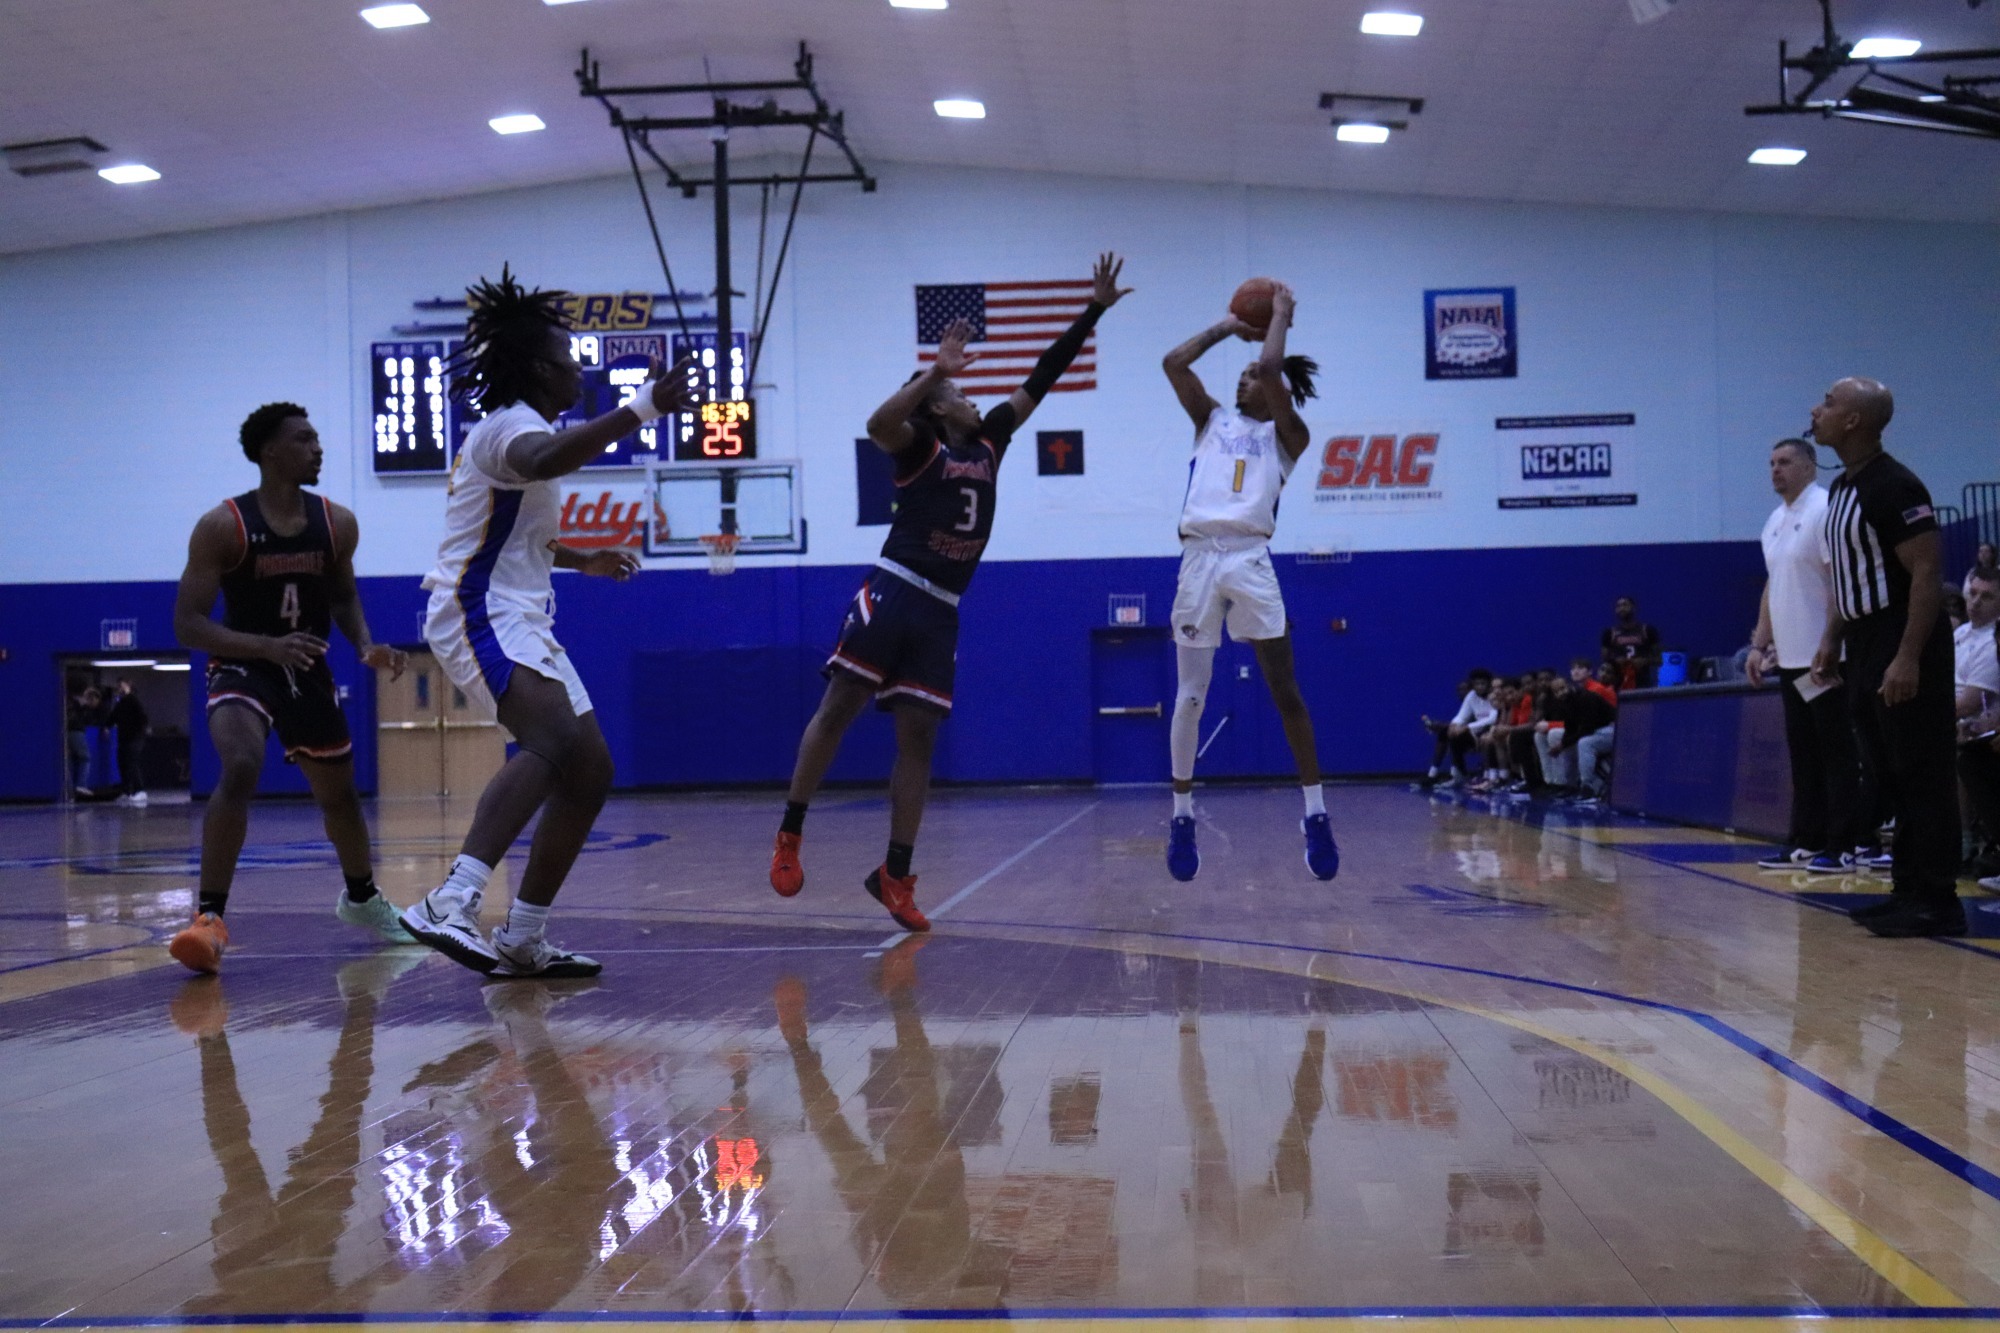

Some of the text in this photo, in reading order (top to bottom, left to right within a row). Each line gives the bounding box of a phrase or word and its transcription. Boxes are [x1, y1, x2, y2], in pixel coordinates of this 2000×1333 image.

[1440, 306, 1499, 329] NAIA
[391, 378, 398, 394] 1
[385, 396, 398, 413] 4
[402, 395, 415, 413] 2
[702, 402, 750, 423] 16:39
[375, 414, 399, 433] 23
[402, 414, 415, 433] 2
[432, 413, 443, 432] 3
[377, 431, 443, 452] 32 1 7
[640, 428, 657, 450] 4
[703, 422, 743, 456] 25
[1316, 432, 1440, 490] SAC
[1523, 445, 1609, 474] NCCAA
[1232, 459, 1246, 493] 1
[1390, 490, 1443, 501] CONFERENCE
[954, 487, 978, 531] 3
[279, 582, 302, 628] 4
